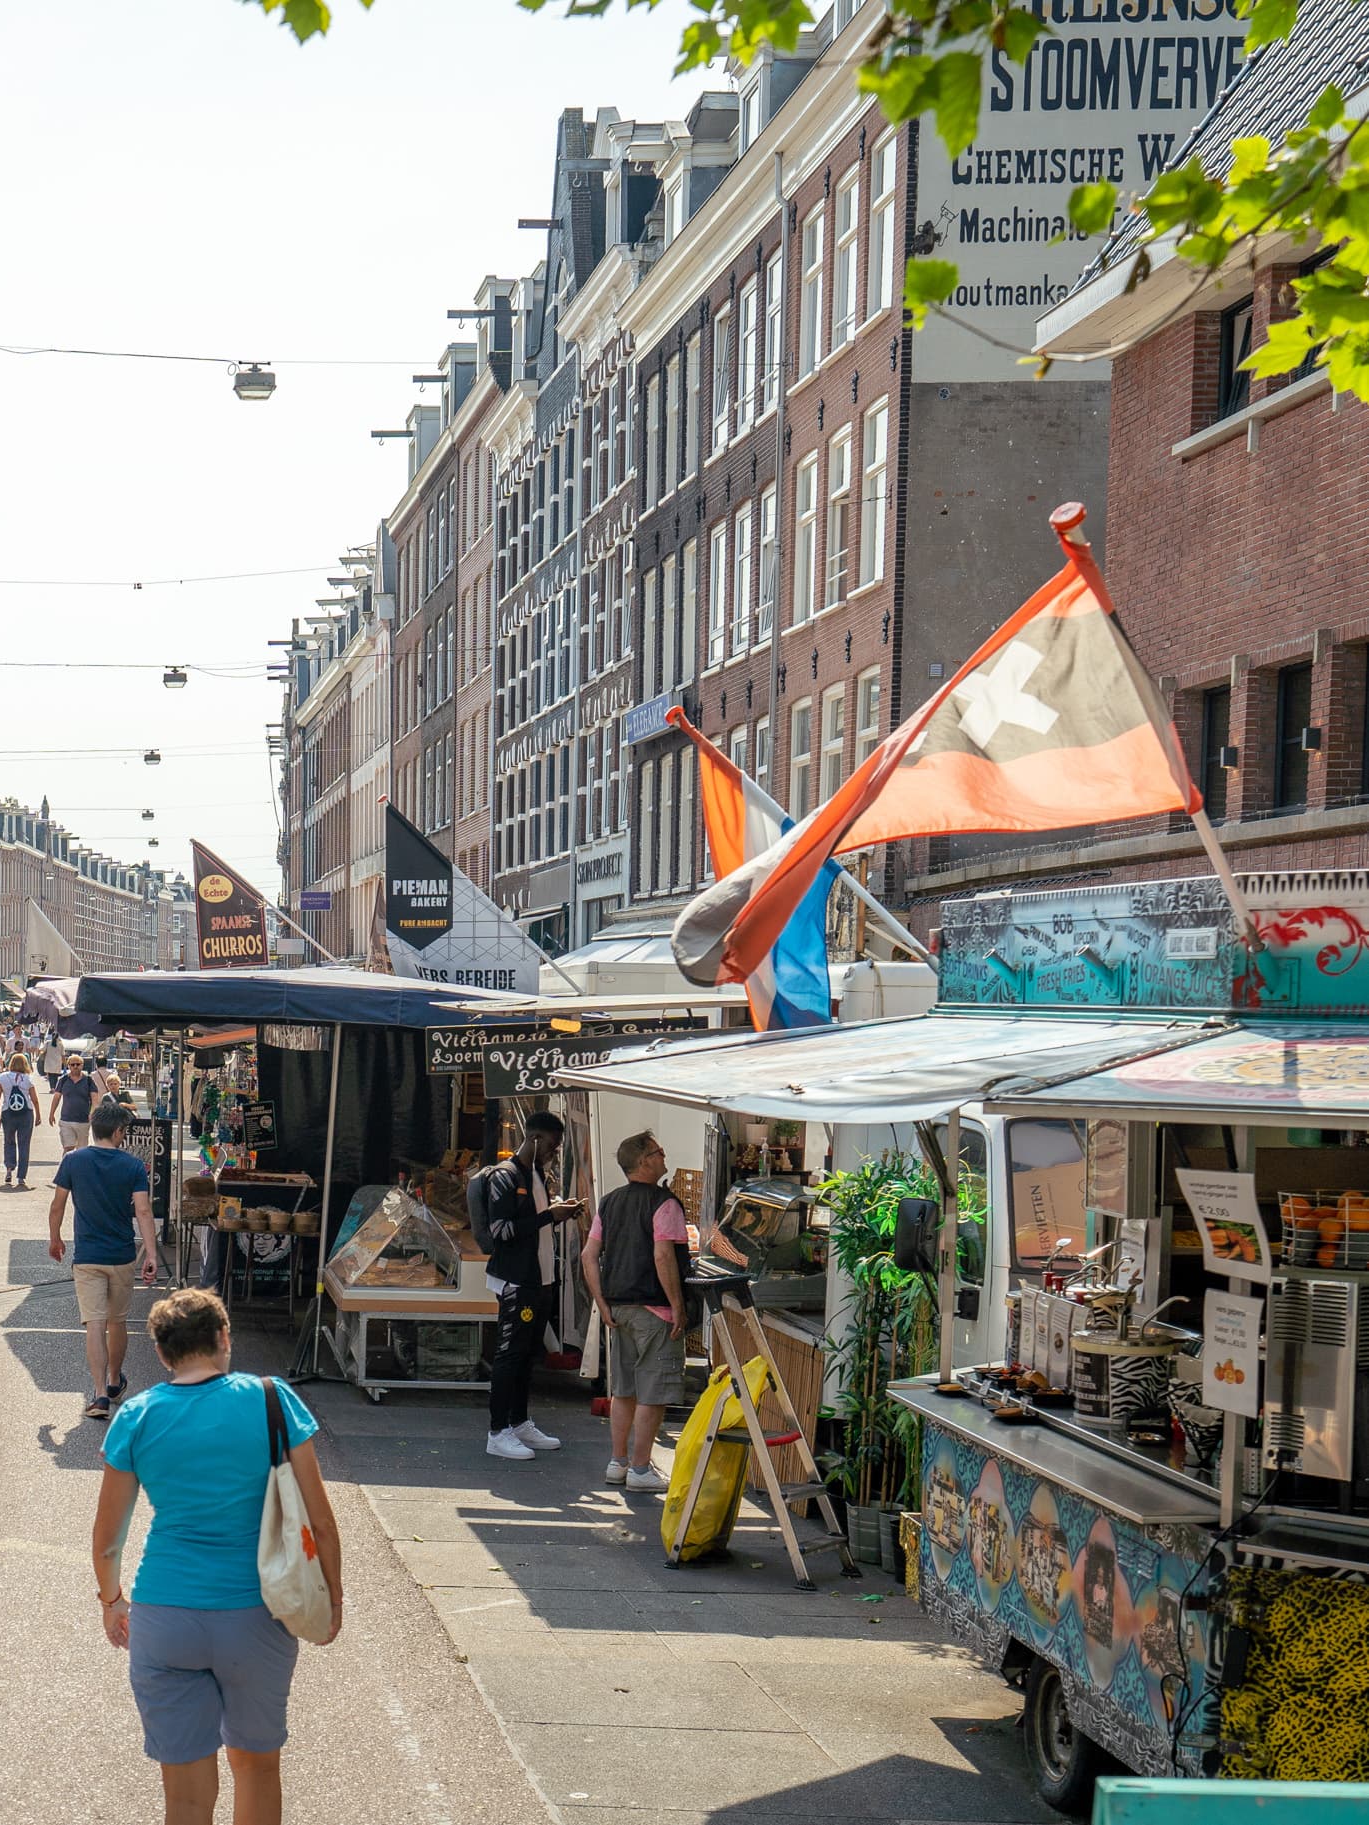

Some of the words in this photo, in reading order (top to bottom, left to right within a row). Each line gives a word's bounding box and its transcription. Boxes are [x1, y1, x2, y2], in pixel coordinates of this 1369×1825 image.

[1138, 134, 1175, 181] W
[209, 877, 221, 885] de
[392, 879, 449, 896] PIEMAN
[203, 888, 229, 898] Echte
[410, 897, 448, 908] BAKERY
[1052, 913, 1074, 935] BOB
[203, 934, 263, 959] CHURROS
[455, 969, 517, 990] BEREIDE
[1037, 972, 1062, 993] FRESH
[1062, 964, 1086, 987] FRIES
[1144, 963, 1187, 989] ORANGE
